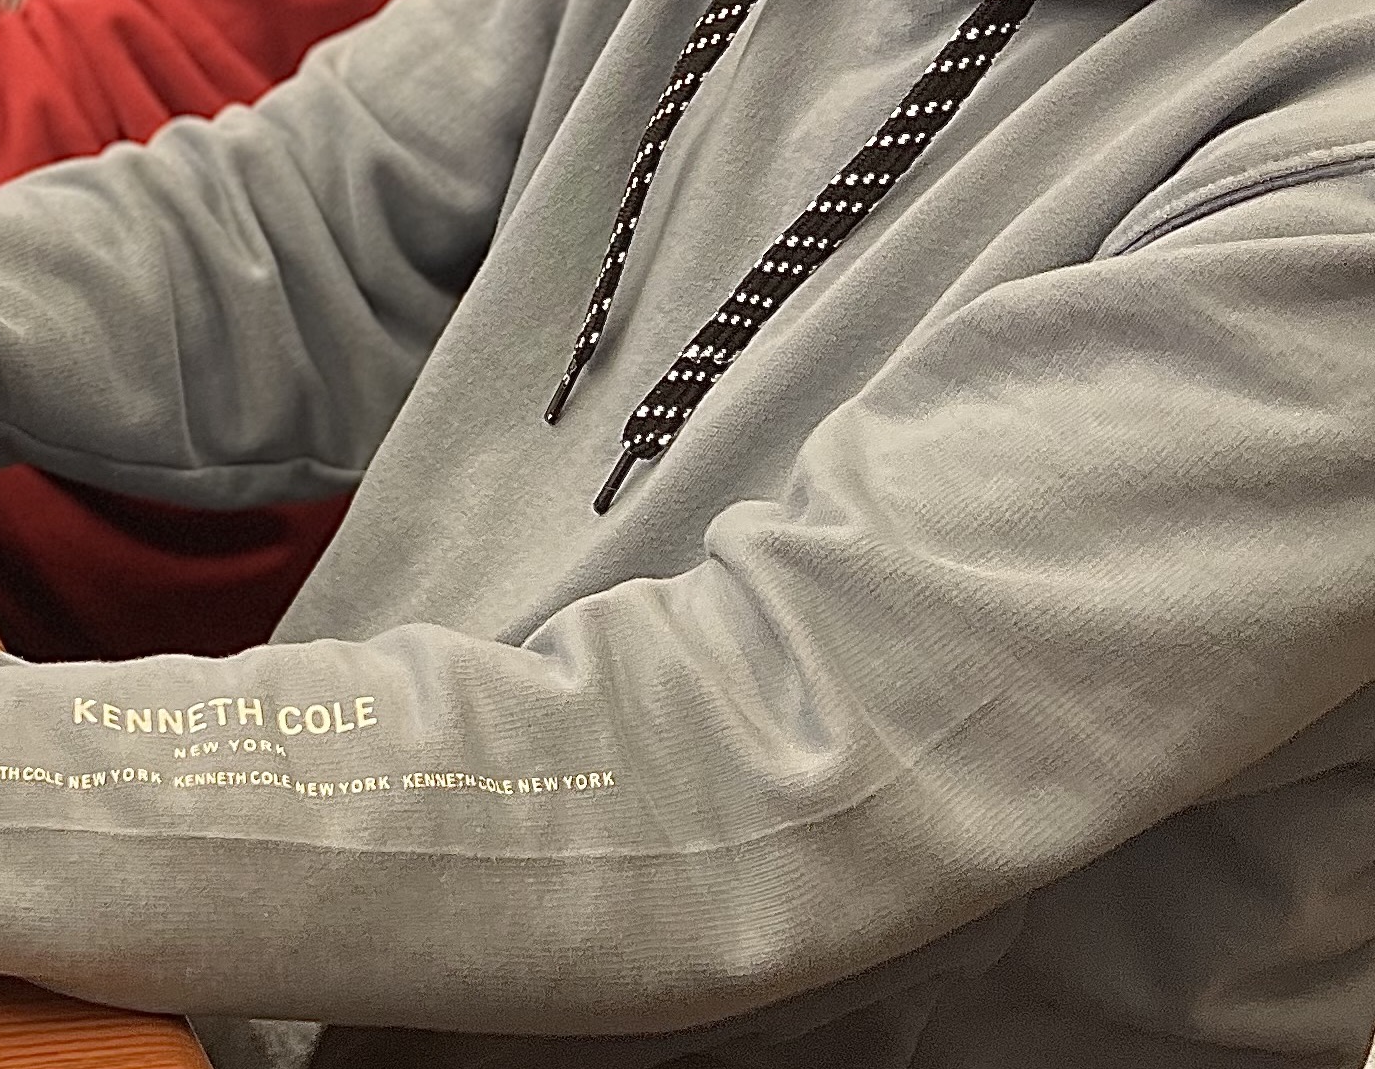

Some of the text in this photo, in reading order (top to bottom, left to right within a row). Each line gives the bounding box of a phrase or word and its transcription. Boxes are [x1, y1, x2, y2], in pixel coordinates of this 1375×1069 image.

[74, 696, 378, 736] KENNETH COLE
[174, 738, 287, 759] NEW YORK
[22, 766, 64, 786] COLE
[68, 771, 106, 790] NEW
[110, 767, 163, 784] YORK
[174, 771, 247, 788] KENNETH
[250, 770, 293, 789] COLE
[295, 780, 334, 797] NEW
[339, 775, 391, 795] YORK
[401, 772, 475, 791] KENNETH
[478, 775, 514, 795] COLE
[518, 776, 558, 794] NEW
[562, 770, 615, 790] YORK
